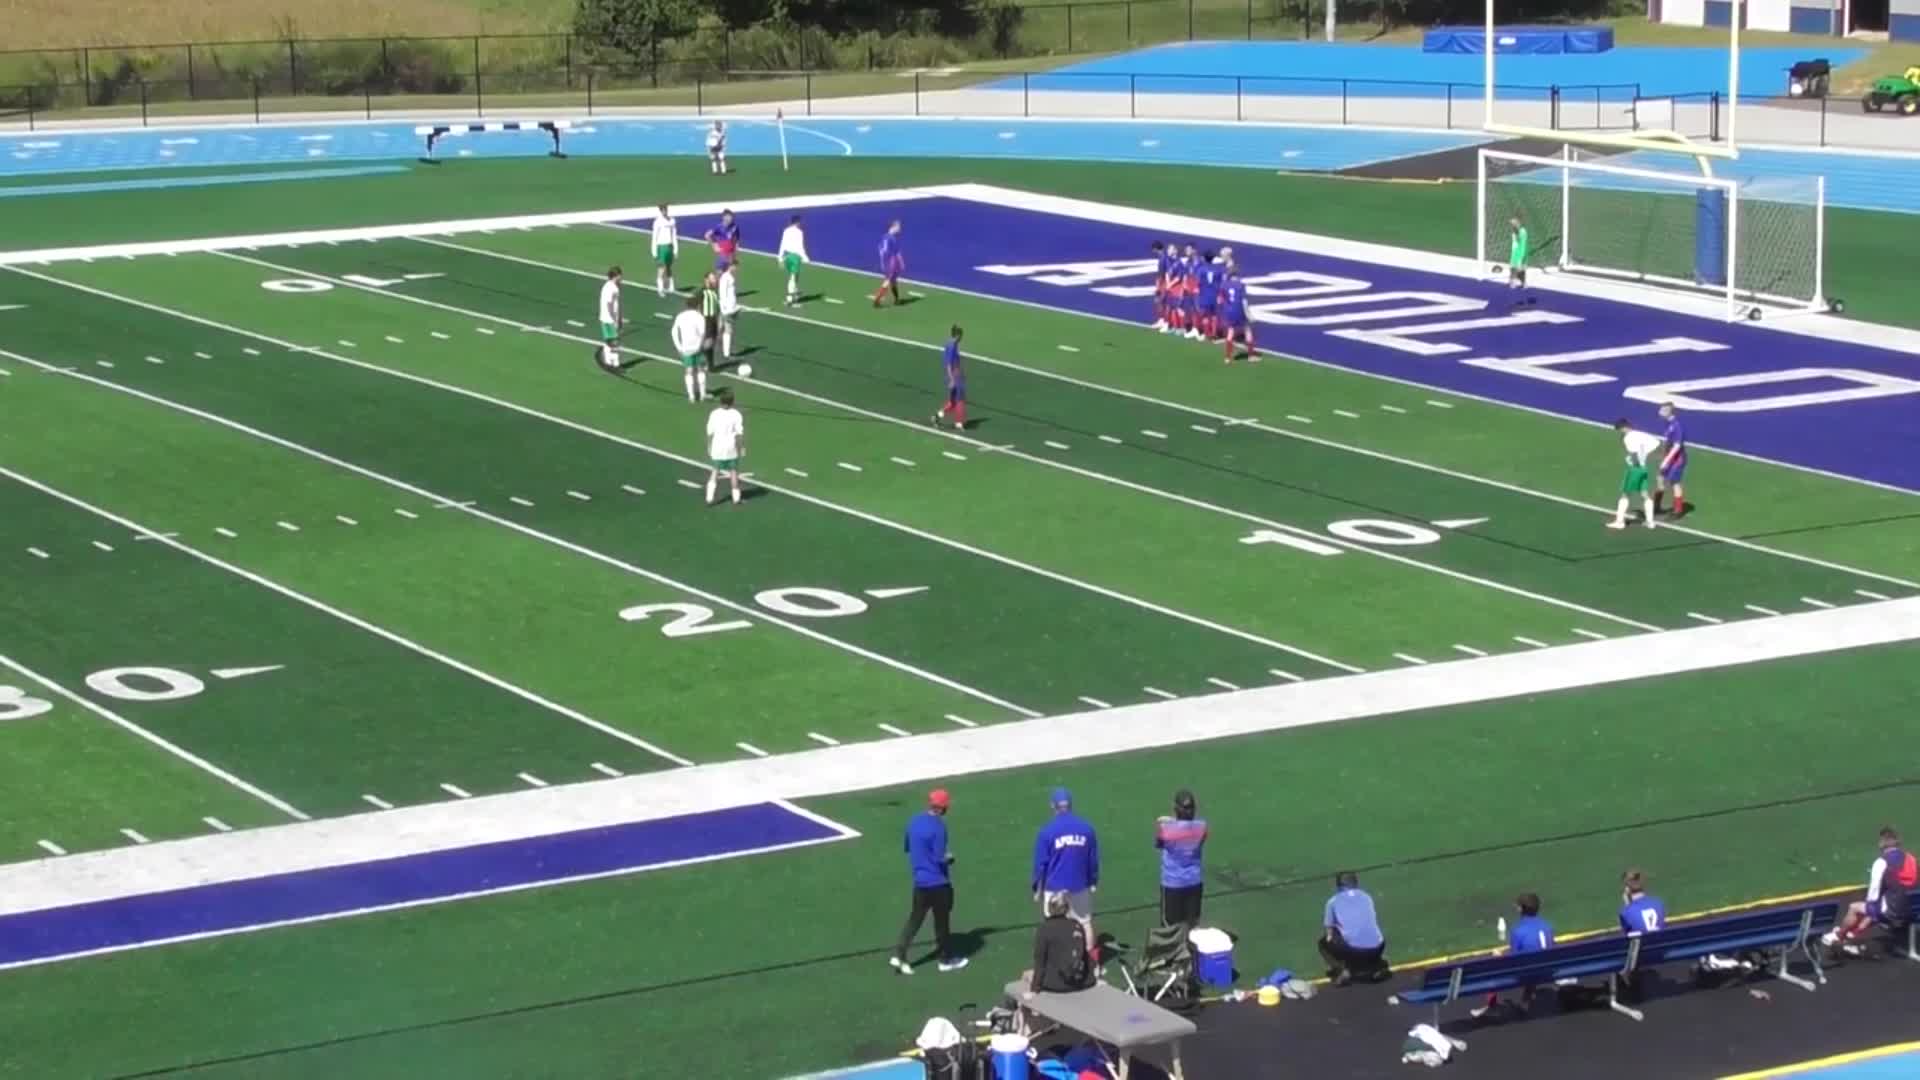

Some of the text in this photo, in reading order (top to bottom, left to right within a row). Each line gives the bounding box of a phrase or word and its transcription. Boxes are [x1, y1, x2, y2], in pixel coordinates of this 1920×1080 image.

[972, 257, 1920, 412] APOLLO
[1238, 519, 1441, 555] 10
[618, 587, 868, 637] 20
